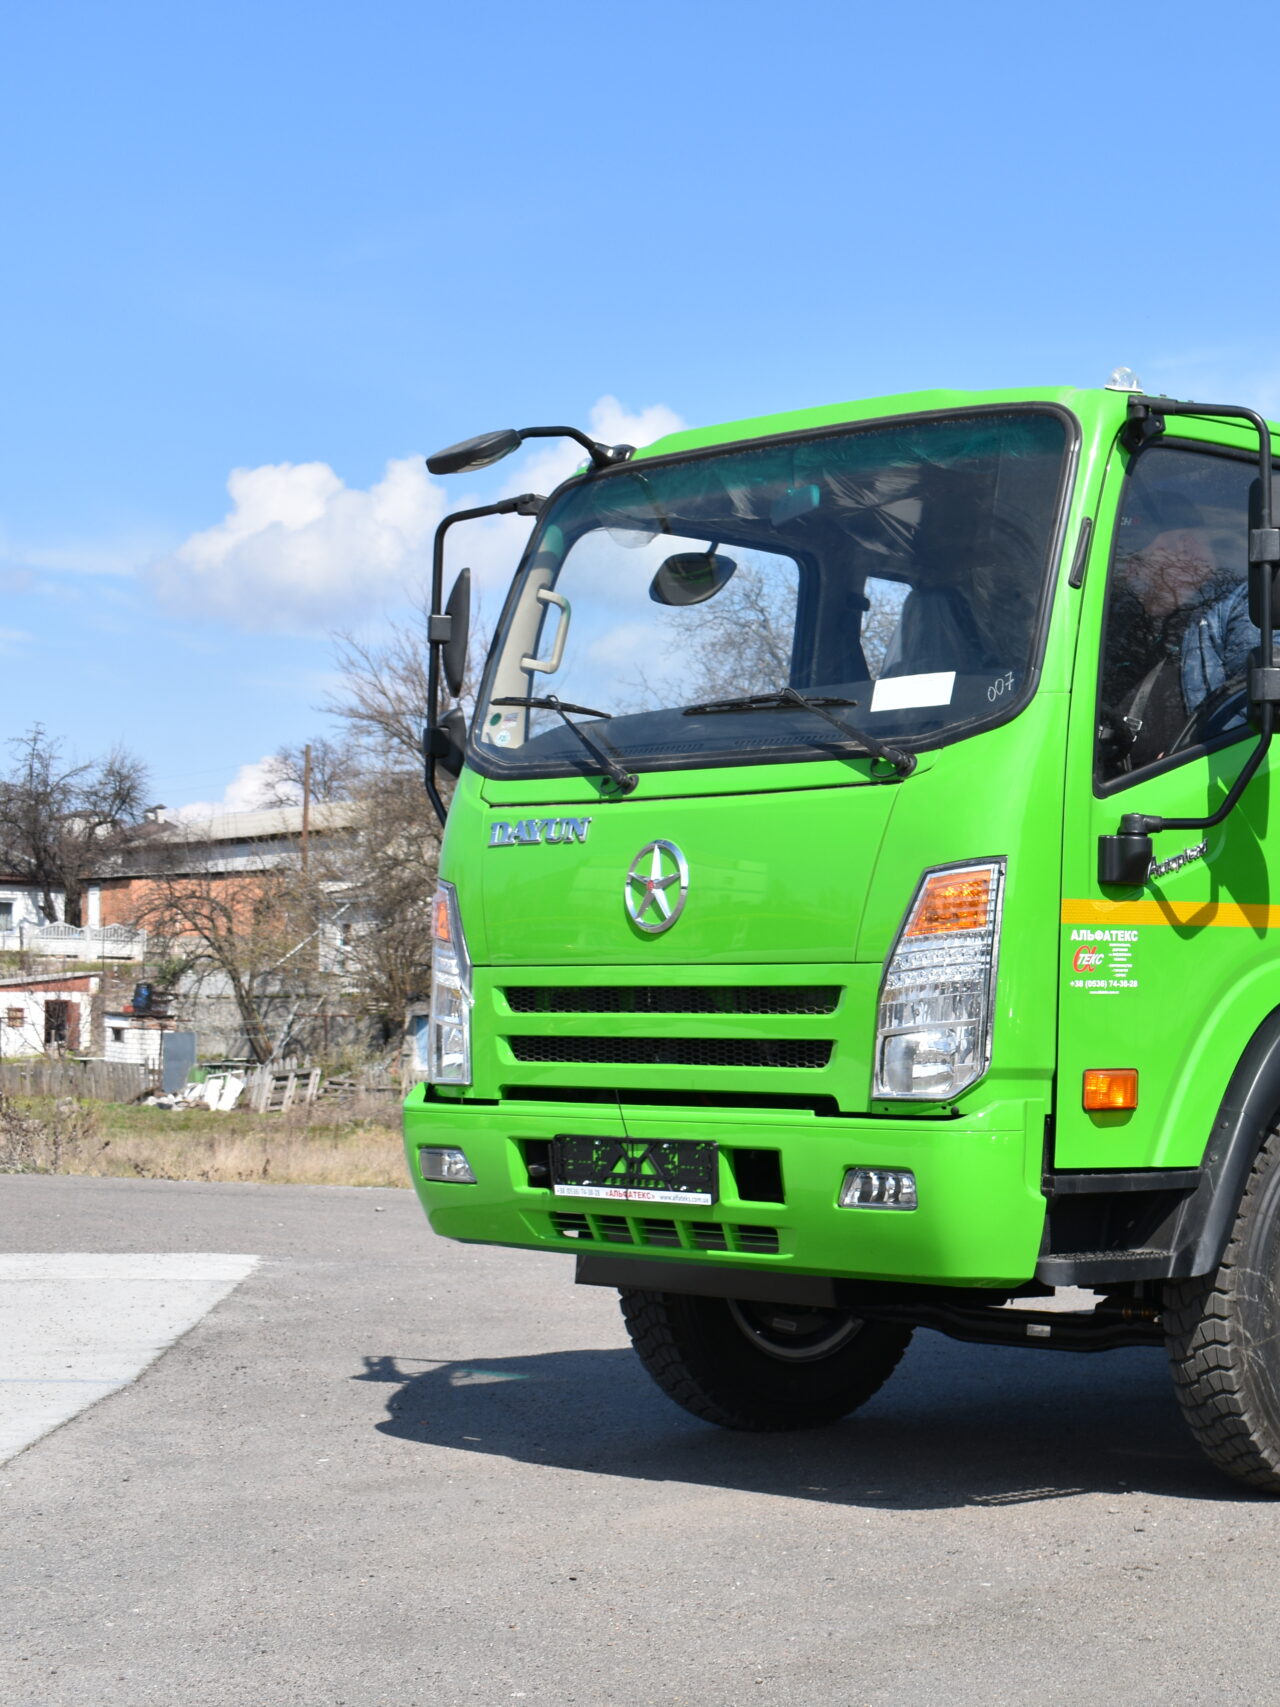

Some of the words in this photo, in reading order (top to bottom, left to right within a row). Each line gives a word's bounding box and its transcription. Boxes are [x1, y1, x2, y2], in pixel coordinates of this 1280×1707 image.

[987, 671, 1015, 702] 007
[488, 817, 592, 847] DAYUN
[1070, 929, 1139, 942] АЛЬФАТЕКС
